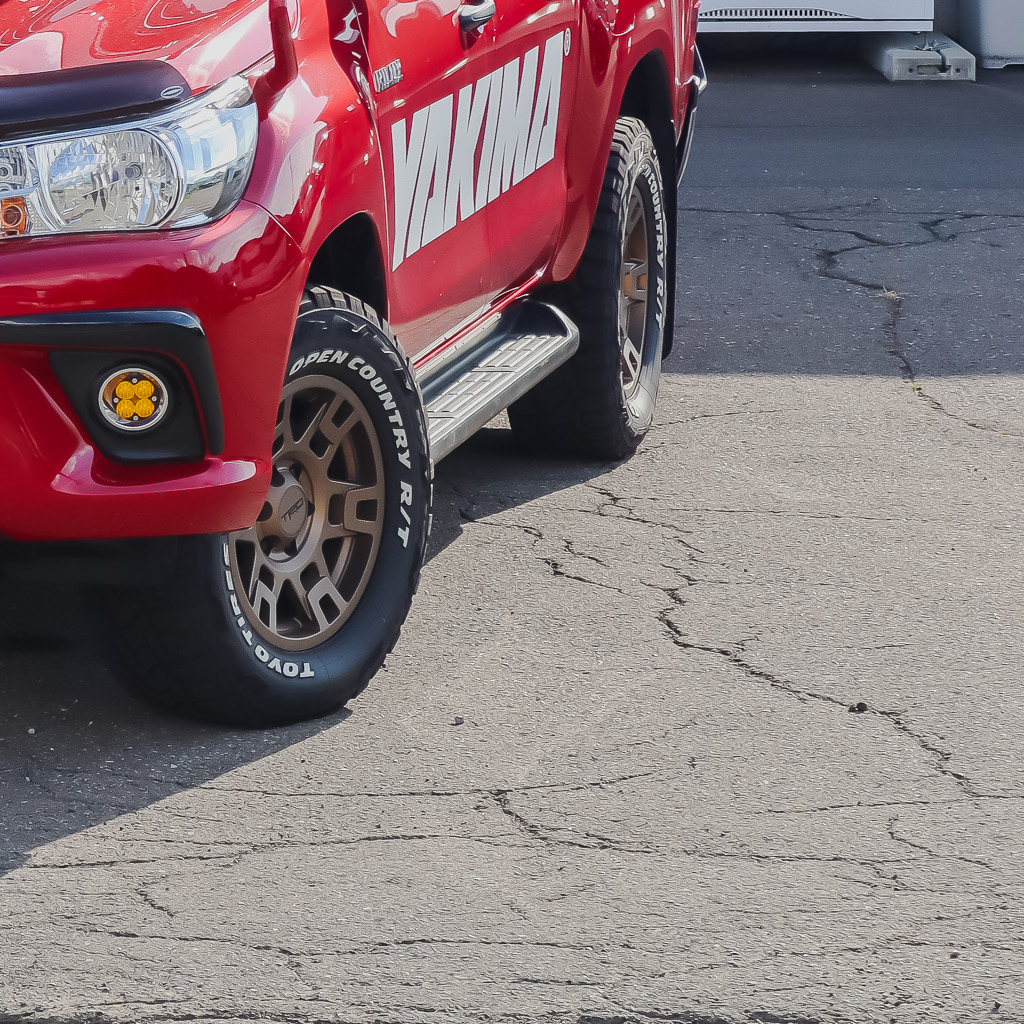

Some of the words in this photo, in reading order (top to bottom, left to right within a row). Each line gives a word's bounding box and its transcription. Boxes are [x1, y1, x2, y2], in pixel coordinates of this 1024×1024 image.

[391, 31, 565, 273] YAKIMA
[647, 173, 664, 269] COUNTRY
[289, 349, 349, 377] OPEN
[347, 357, 411, 469] COUNTRY
[397, 480, 413, 549] R/T
[280, 497, 304, 522] TRD
[254, 644, 315, 678] TOYO
